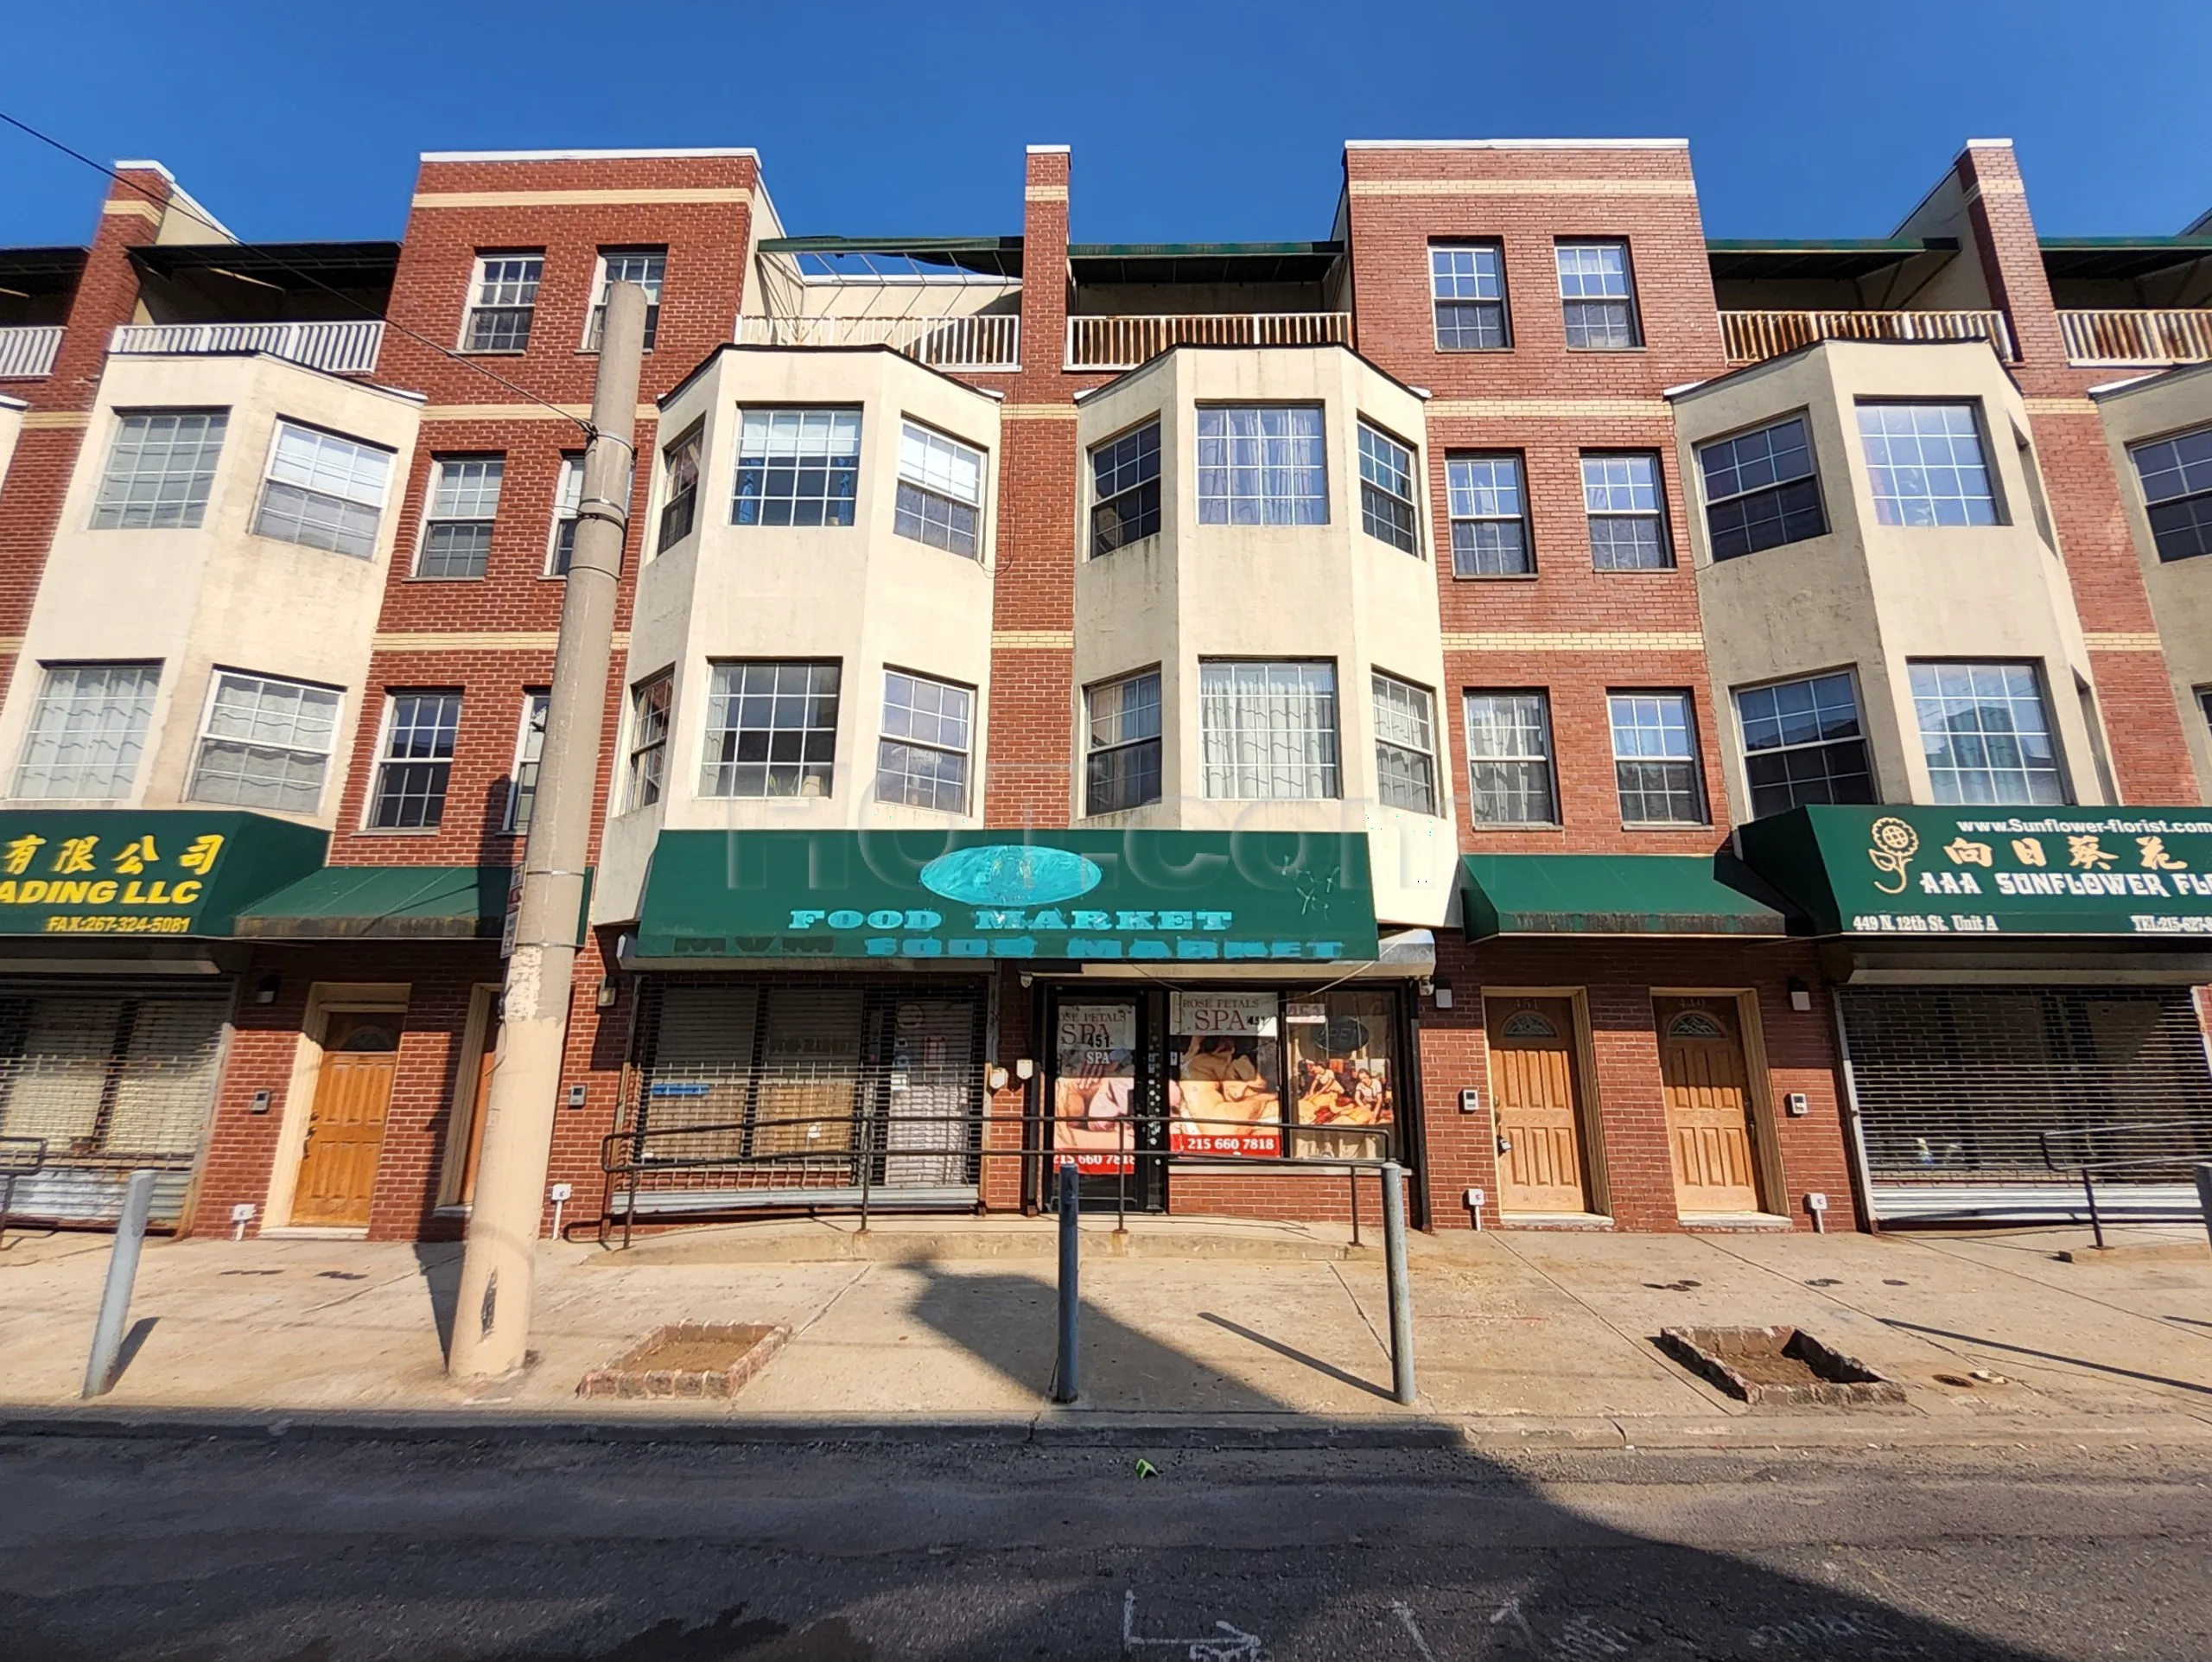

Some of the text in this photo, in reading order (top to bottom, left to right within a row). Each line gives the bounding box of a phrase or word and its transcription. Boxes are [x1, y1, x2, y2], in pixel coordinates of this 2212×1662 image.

[3, 834, 225, 876] 有限公司
[1943, 835, 2188, 870] 向日葵花
[121, 880, 203, 904] LLC
[1919, 872, 1983, 894] AAA
[1994, 873, 2171, 897] SUNFLOWER
[47, 916, 191, 933] FAX:267-324-5081
[788, 907, 1233, 931] FOOD MARKET
[1853, 915, 1878, 931] 449
[1897, 914, 1928, 931] 12th
[1951, 914, 1985, 931] Unit
[1985, 914, 1999, 931] A
[1066, 937, 1343, 958] MARKET
[1183, 998, 1259, 1009] ROSE PETALS
[1194, 1009, 1247, 1031] SPA
[1061, 1023, 1110, 1045] SPA
[1086, 1051, 1110, 1064] SPA
[1187, 1138, 1274, 1149] 215 660 7818
